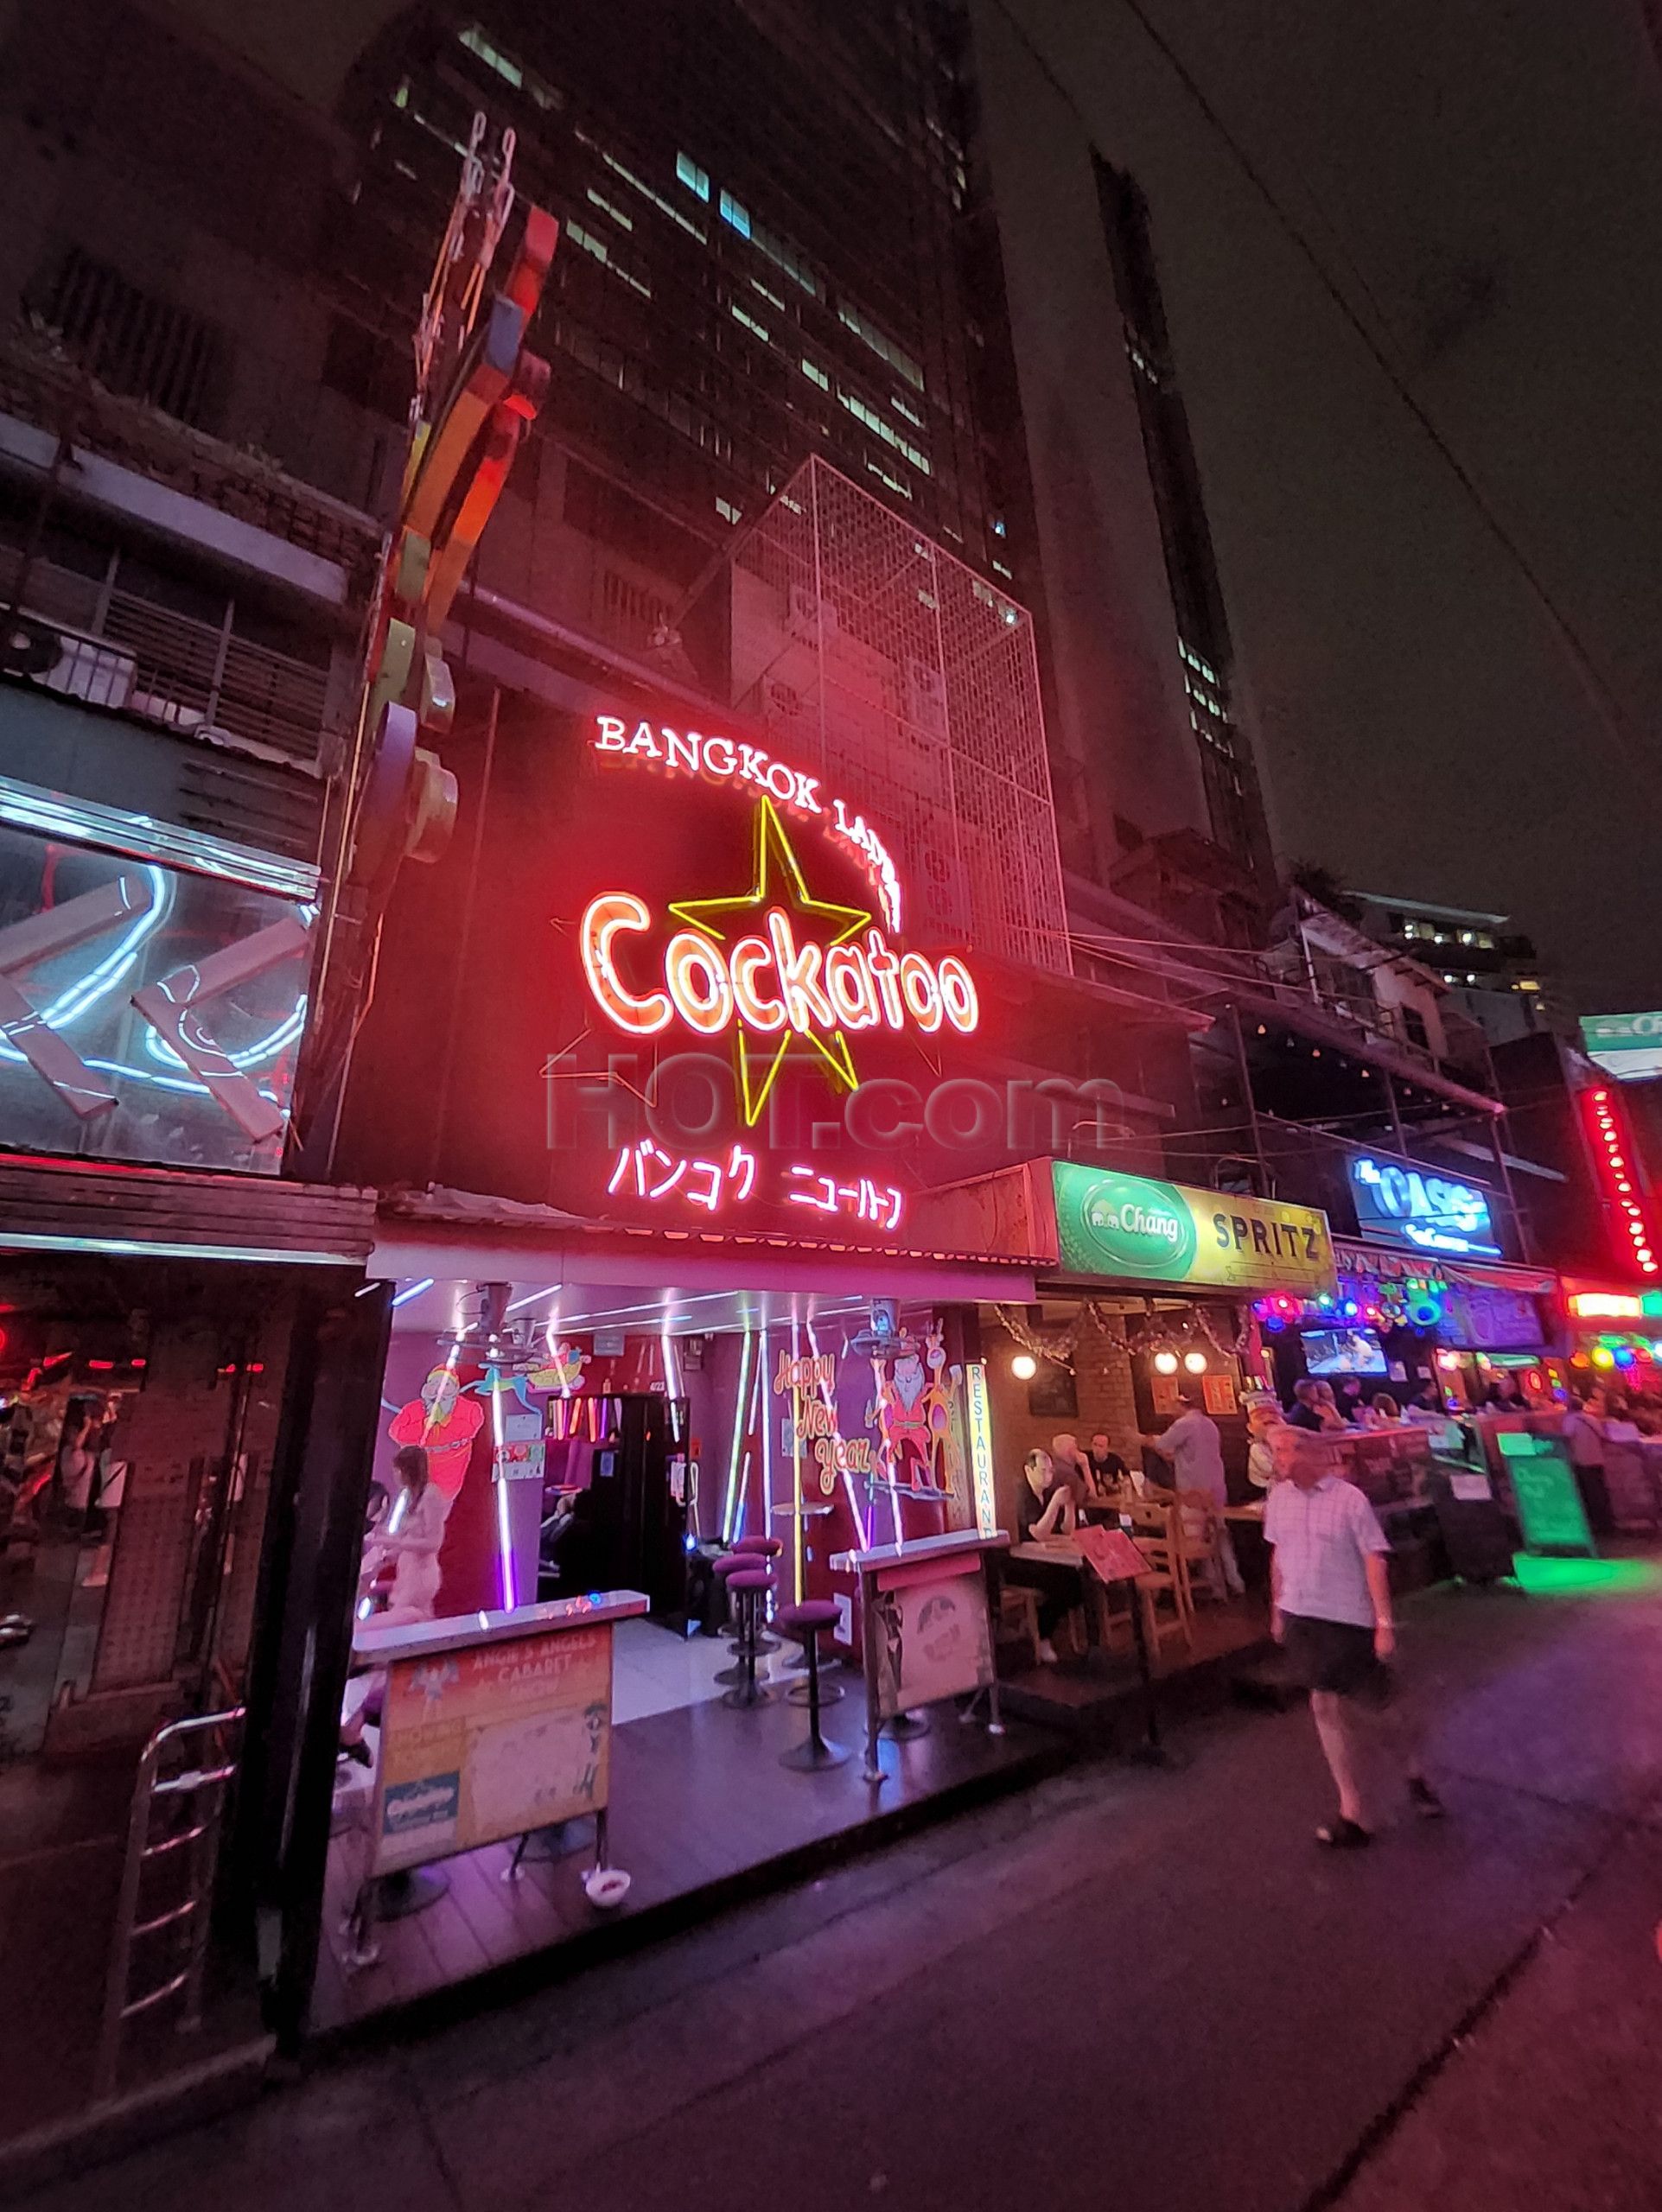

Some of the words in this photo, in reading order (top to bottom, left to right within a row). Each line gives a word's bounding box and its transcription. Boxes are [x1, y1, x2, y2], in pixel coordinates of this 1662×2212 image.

[594, 715, 823, 815] BANGKOK
[580, 891, 979, 1035] Cockatoo
[608, 1139, 756, 1211] バンコク
[1120, 1204, 1179, 1243] Chang
[1213, 1212, 1320, 1259] SPRITZ
[774, 1349, 837, 1401] Happy
[498, 1654, 572, 1683] CABARET
